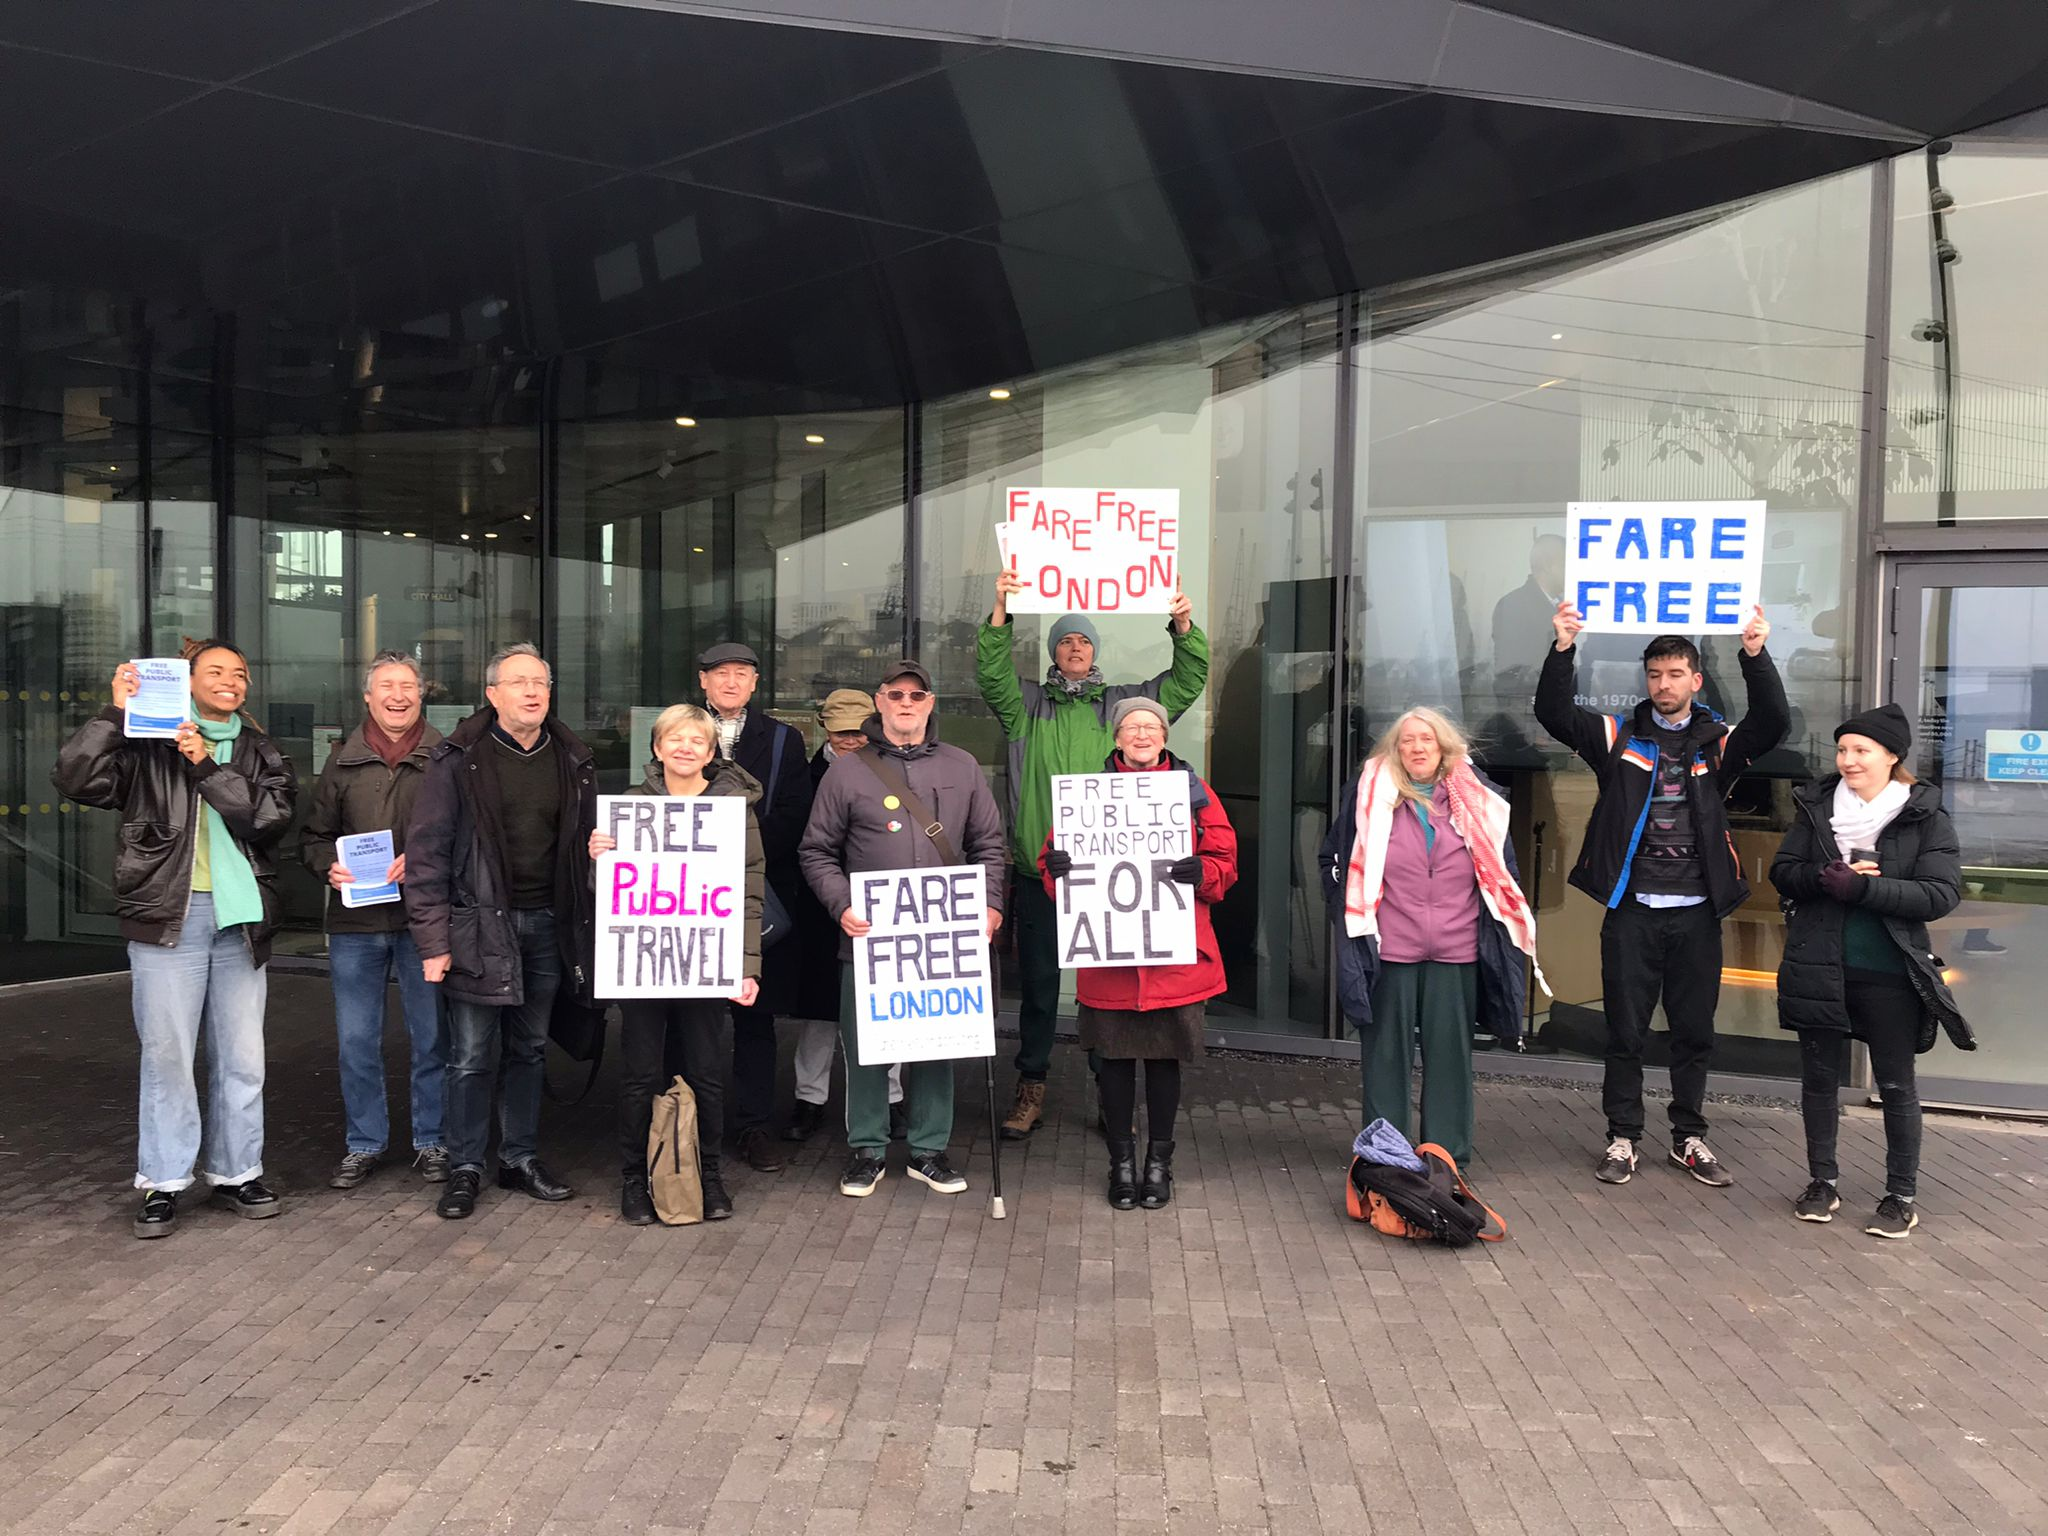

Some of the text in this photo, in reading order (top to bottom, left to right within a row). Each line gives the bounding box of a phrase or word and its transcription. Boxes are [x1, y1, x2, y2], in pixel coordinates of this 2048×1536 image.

[1009, 490, 1177, 551] FARE FREE
[1578, 517, 1747, 560] FARE
[1010, 553, 1173, 611] LONDON
[1576, 580, 1742, 625] FREE
[1573, 694, 1598, 706] the
[1059, 777, 1152, 801] FREE
[1998, 767, 2025, 775] KEEP
[608, 801, 718, 853] FREE
[1060, 802, 1186, 829] PUBLIC
[349, 847, 388, 857] TRANSPORT
[1057, 830, 1188, 857] TRANSPORT
[864, 872, 980, 927] FARE
[1063, 859, 1187, 914] FOR
[608, 925, 735, 988] TRAVEL
[867, 929, 983, 985] FREE
[1066, 910, 1173, 963] ALL
[869, 985, 984, 1022] LONDON
